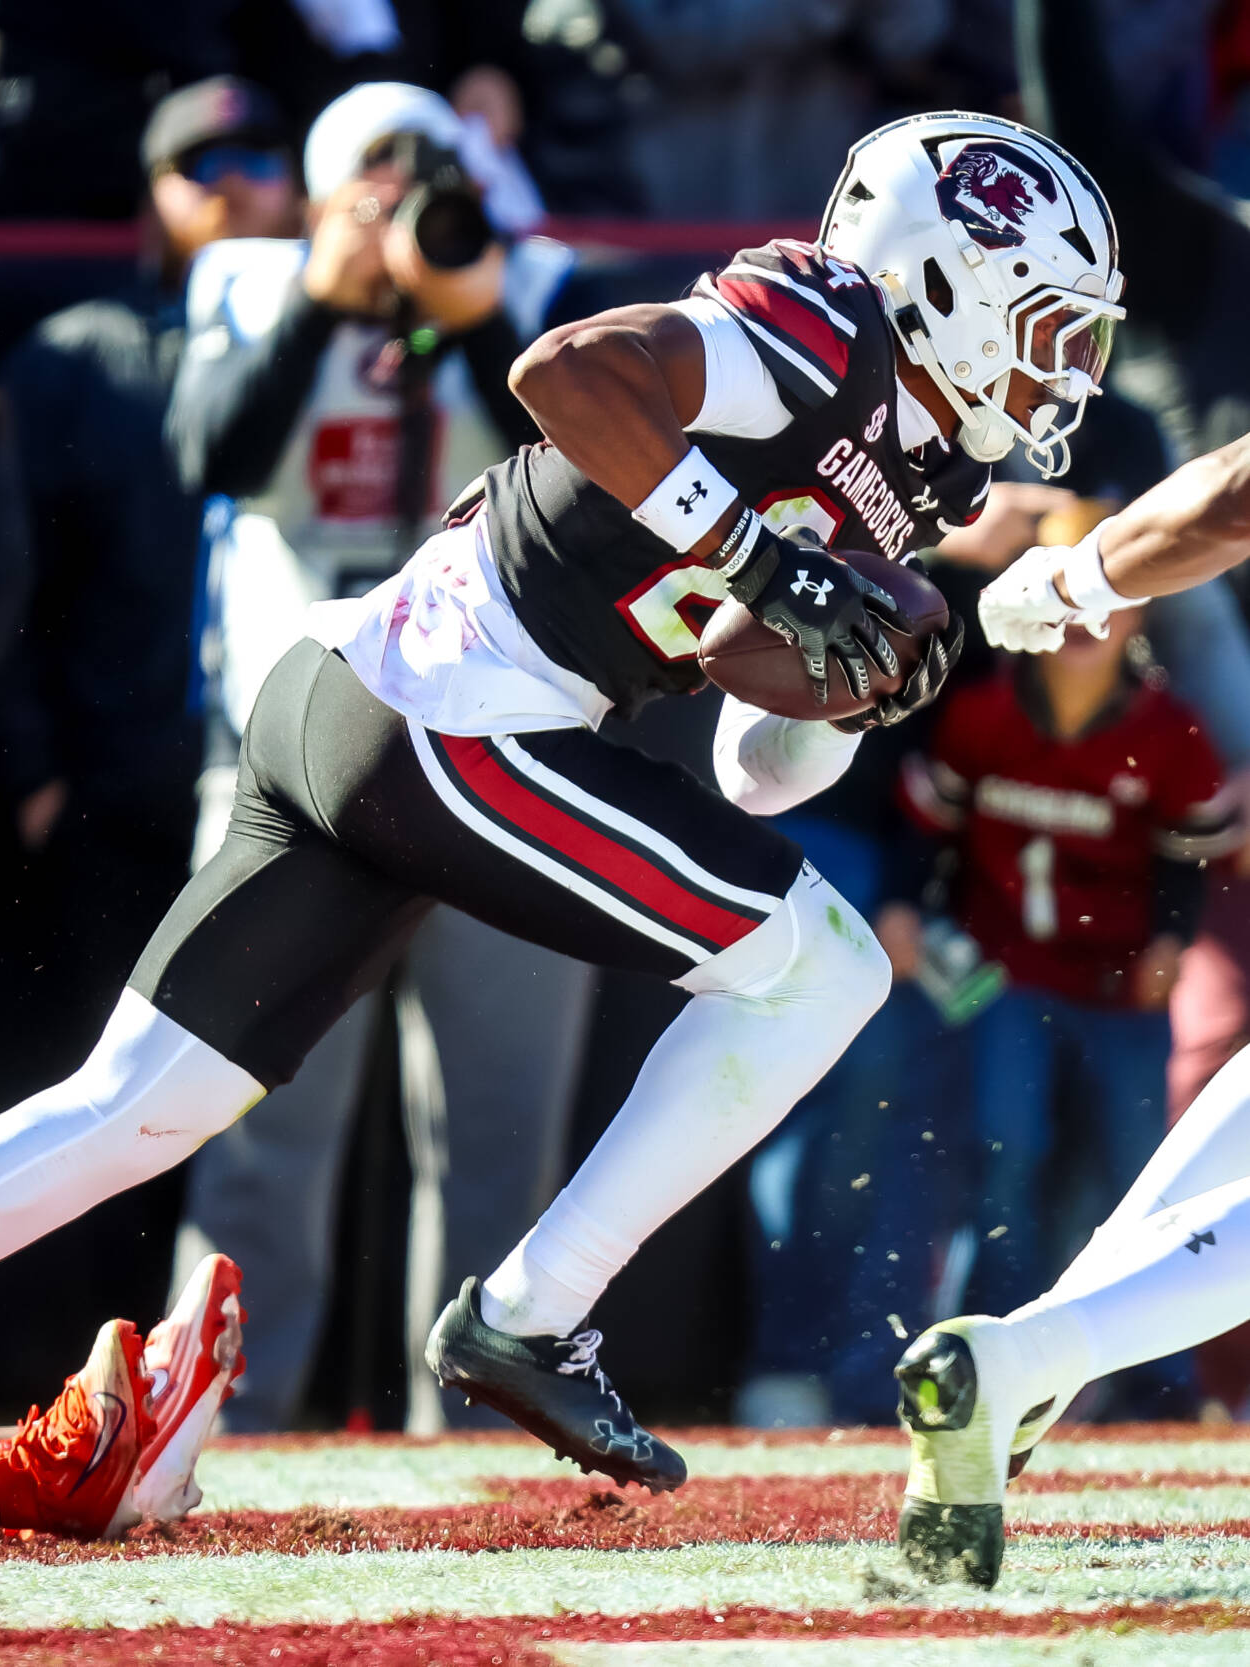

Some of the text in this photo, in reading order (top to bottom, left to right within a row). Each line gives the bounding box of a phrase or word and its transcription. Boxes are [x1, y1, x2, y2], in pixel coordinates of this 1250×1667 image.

[722, 517, 748, 551] SECOND
[817, 438, 915, 561] GAMECOCKS
[729, 552, 744, 570] GOD
[1020, 835, 1057, 940] 1
